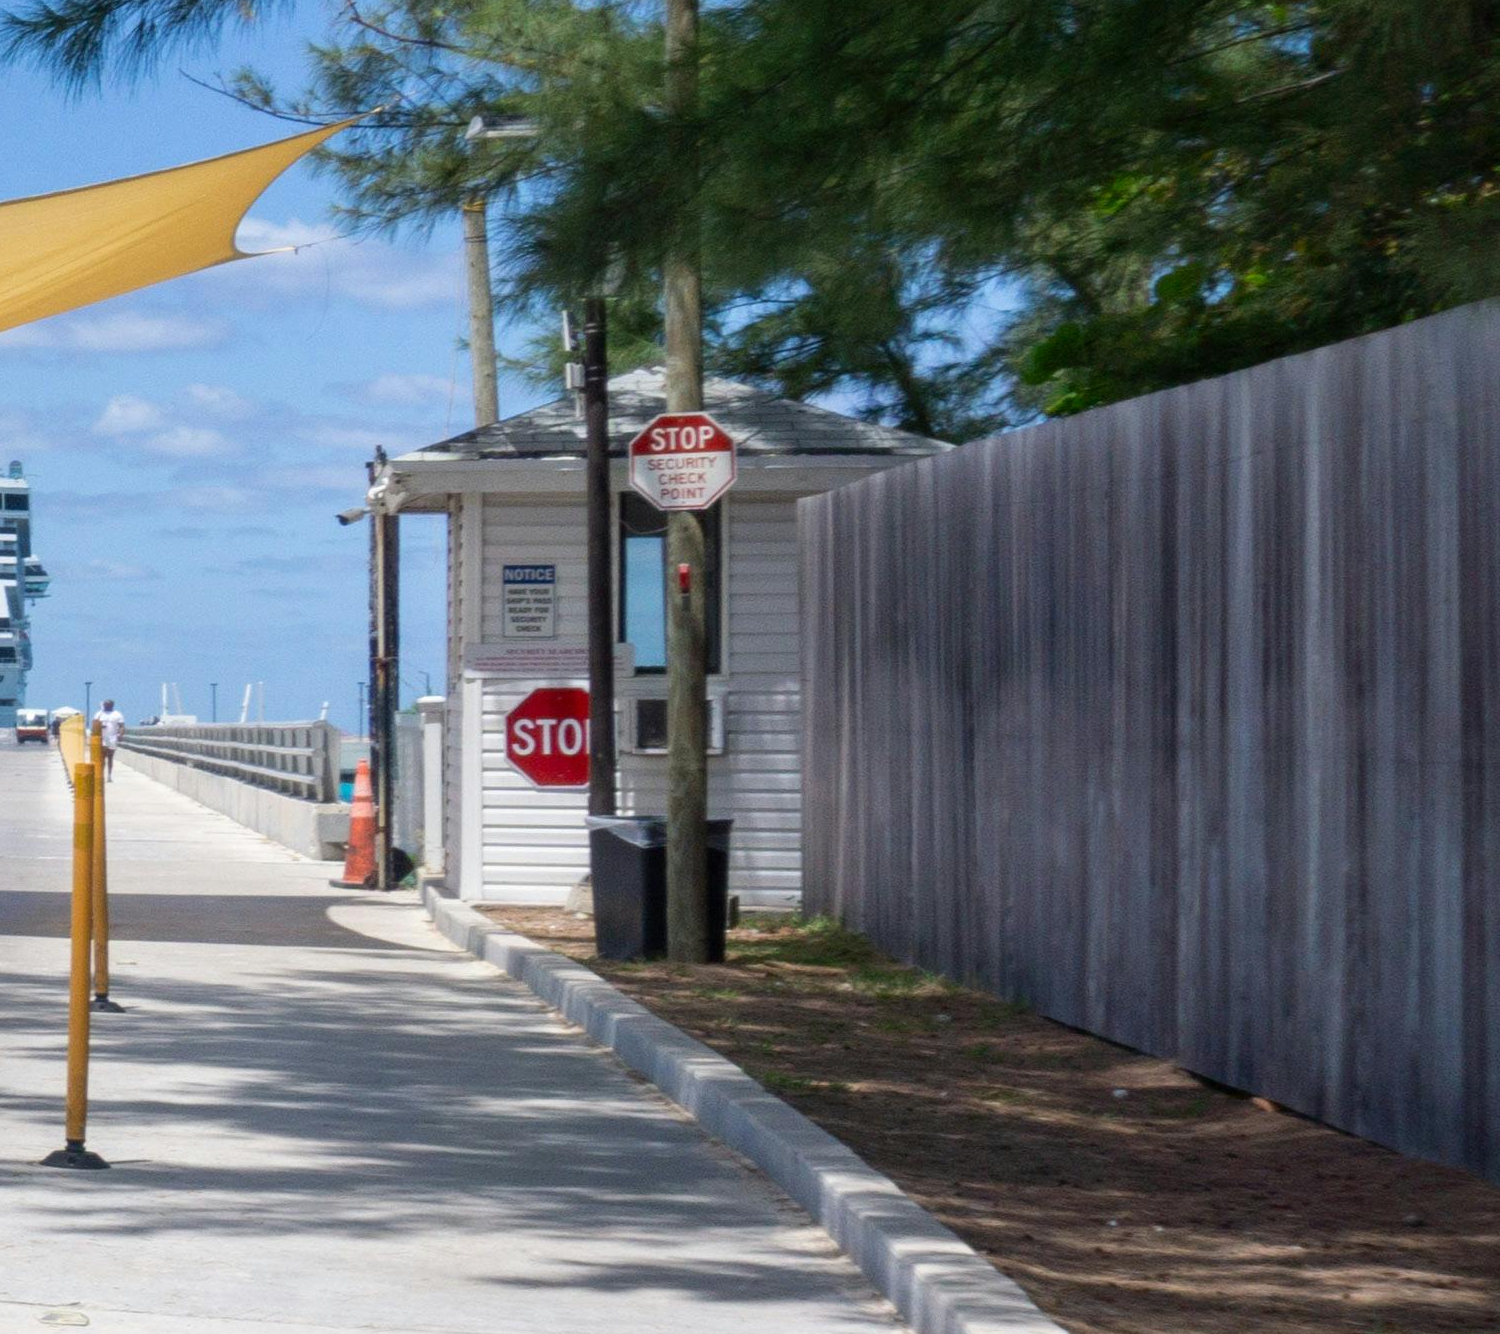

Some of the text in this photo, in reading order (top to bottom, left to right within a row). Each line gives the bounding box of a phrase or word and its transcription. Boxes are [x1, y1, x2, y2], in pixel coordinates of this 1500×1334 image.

[651, 425, 715, 451] STOP
[648, 456, 717, 471] SECURITY
[658, 472, 707, 486] CHECK
[660, 487, 706, 500] POINT
[504, 568, 554, 581] NOTICE
[512, 718, 590, 756] STO
